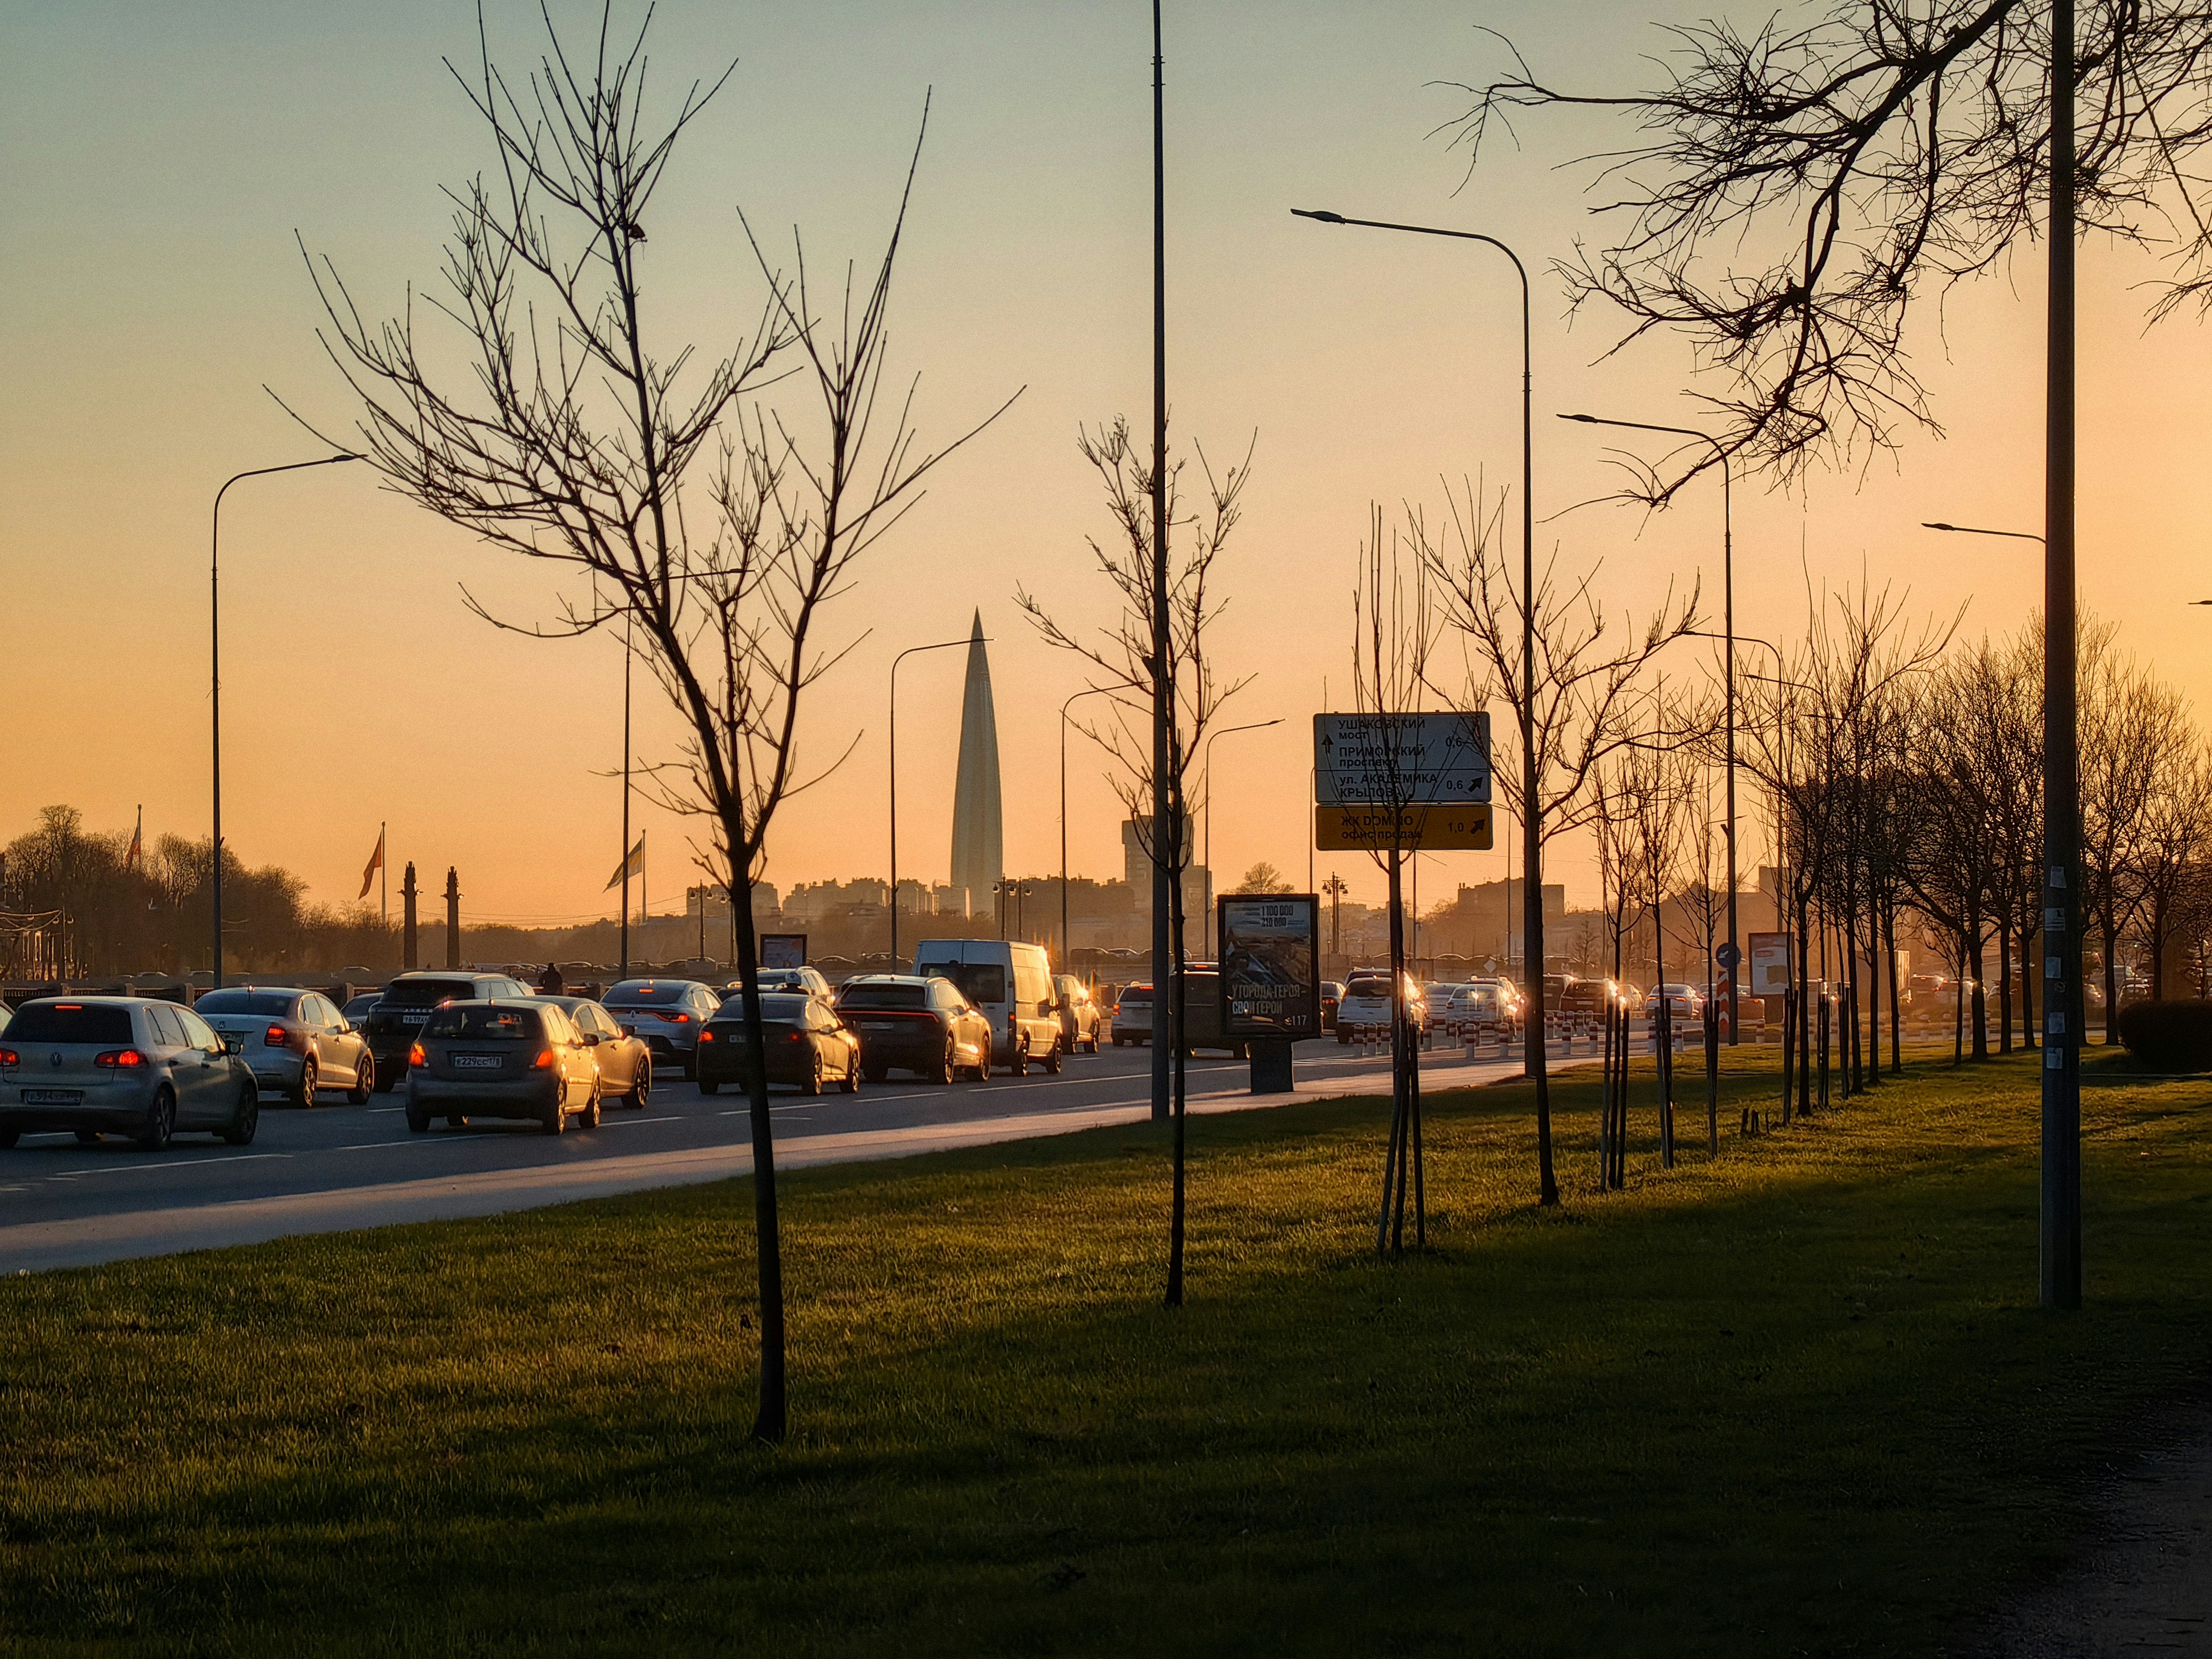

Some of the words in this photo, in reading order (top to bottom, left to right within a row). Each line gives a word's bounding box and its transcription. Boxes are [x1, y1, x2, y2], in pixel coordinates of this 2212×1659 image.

[1338, 717, 1425, 729] УШАКОВСКИЙ
[1446, 737, 1463, 748] 0,6
[1339, 759, 1395, 769] проспект
[1340, 776, 1357, 786] ул.
[1361, 774, 1438, 784] АКАДЕМИКА
[1446, 780, 1463, 791] 0,6
[1340, 787, 1402, 797] КРЫЛОВА
[1340, 816, 1359, 826] ЖК
[1363, 816, 1413, 826] DOMO
[1448, 822, 1464, 833] 1,0
[1342, 830, 1375, 841] офис
